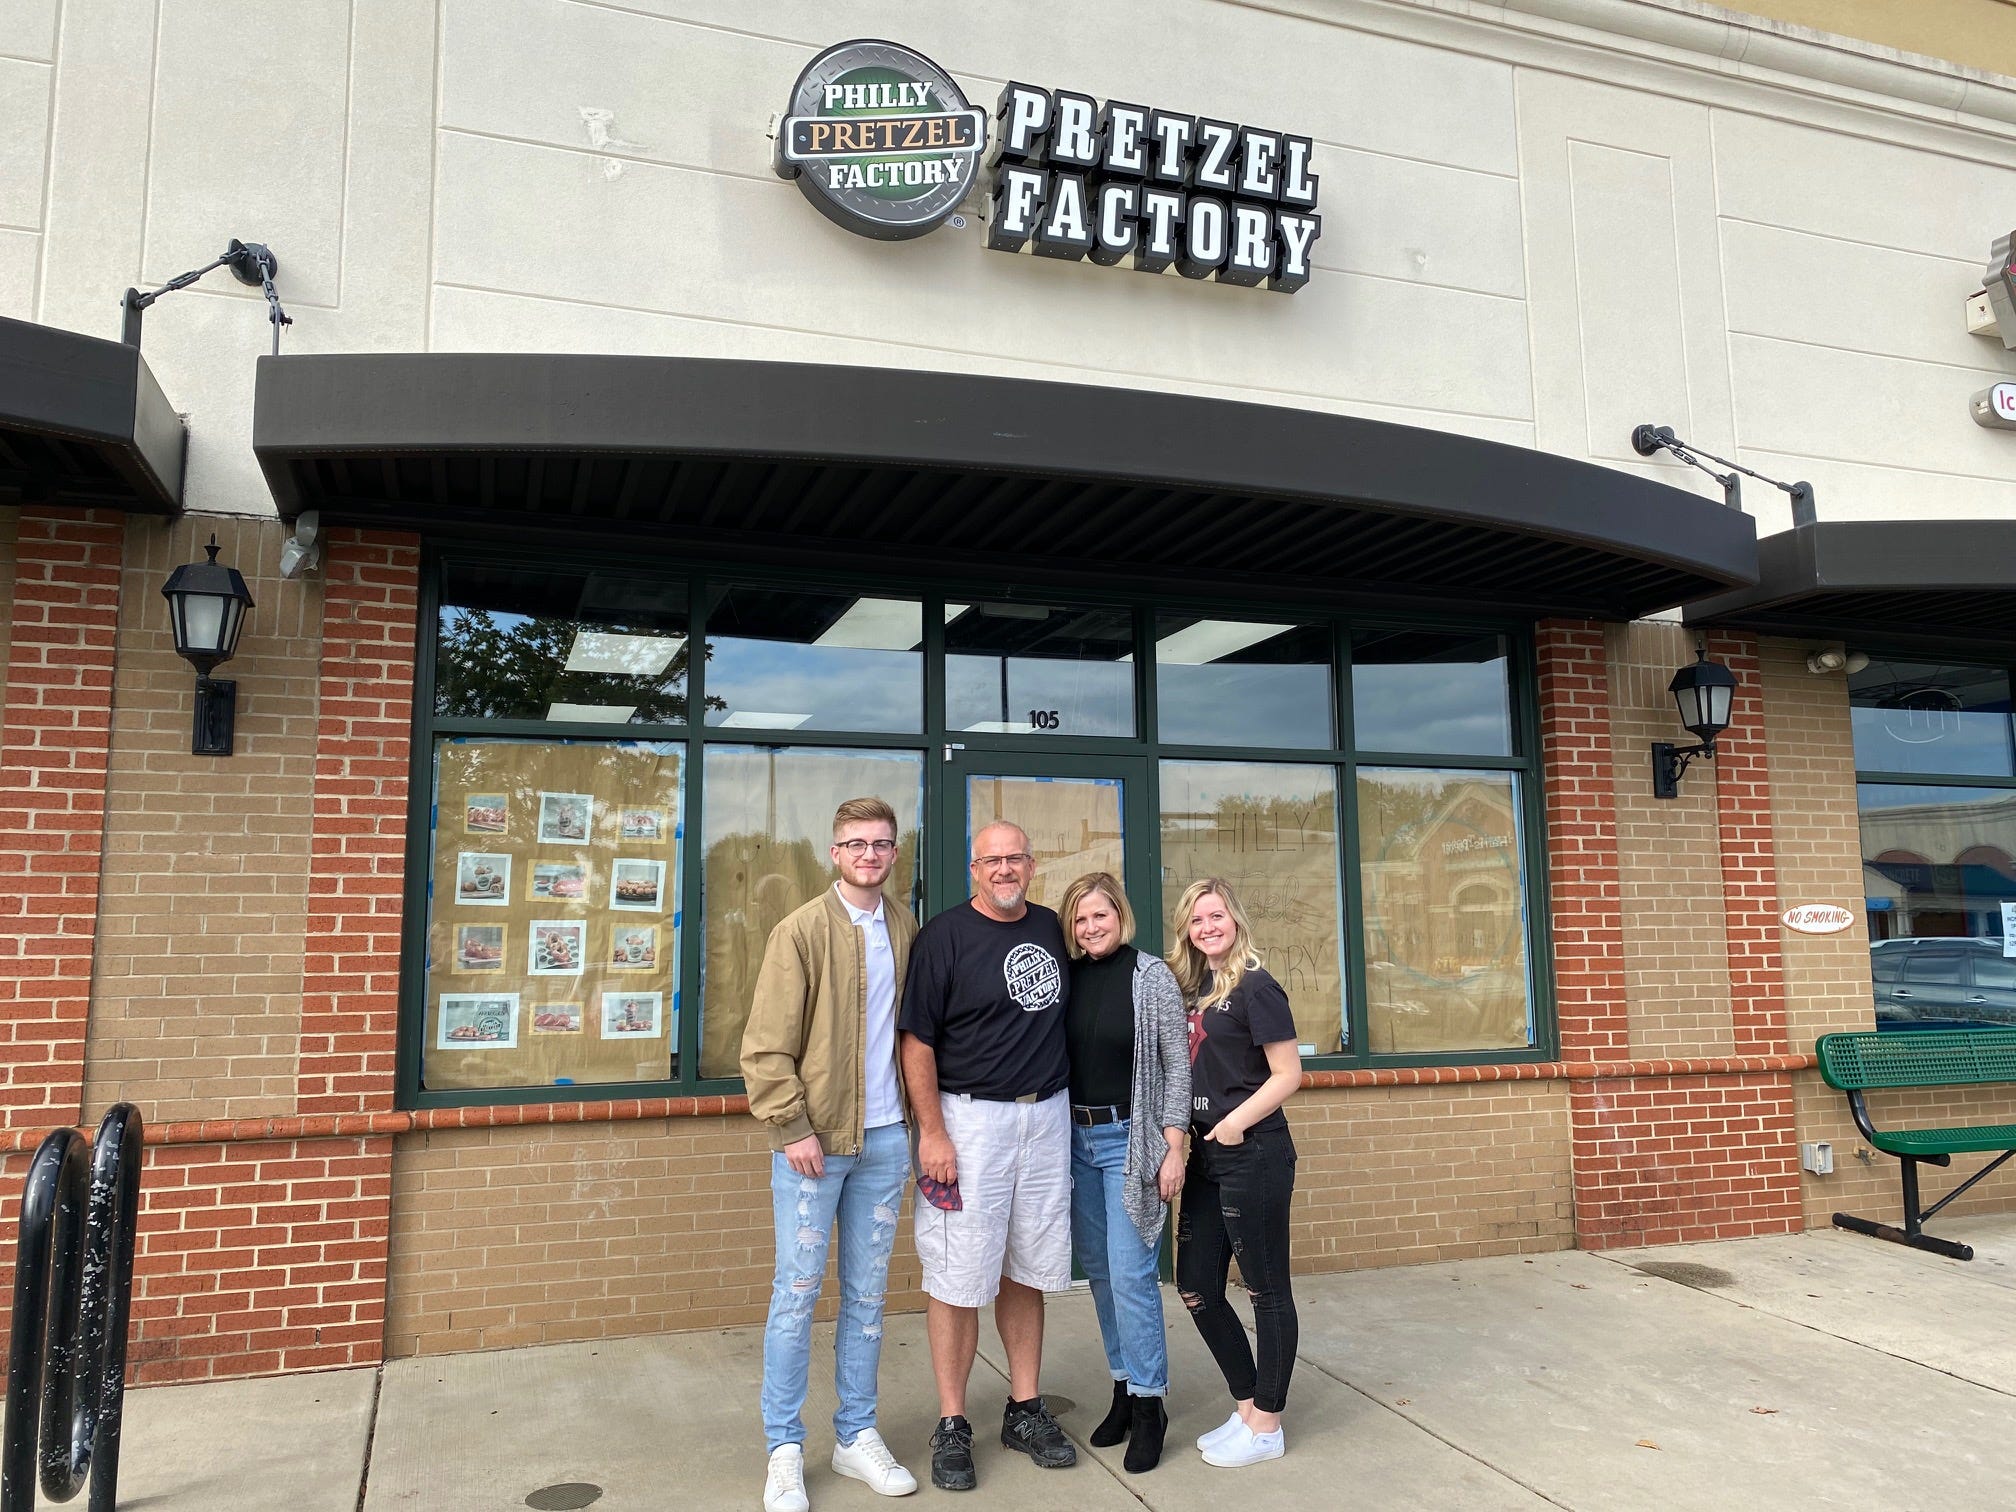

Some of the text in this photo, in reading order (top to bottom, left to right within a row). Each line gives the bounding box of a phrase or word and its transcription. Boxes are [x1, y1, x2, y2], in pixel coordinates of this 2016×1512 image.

[823, 81, 933, 109] PHILLY
[809, 118, 966, 151] PRETZEL
[1010, 89, 1313, 201] PRETZEL
[828, 158, 964, 189] FACTORY
[1003, 170, 1315, 275] FACTORY
[1029, 709, 1060, 730] 105
[1193, 811, 1311, 853] PHILLY
[1788, 911, 1849, 924] NO SMOKING
[1011, 951, 1043, 976] PHILLY
[1013, 961, 1057, 995] PRETZEL
[1019, 978, 1057, 1006] FACTORY
[1193, 1096, 1209, 1110] UR
